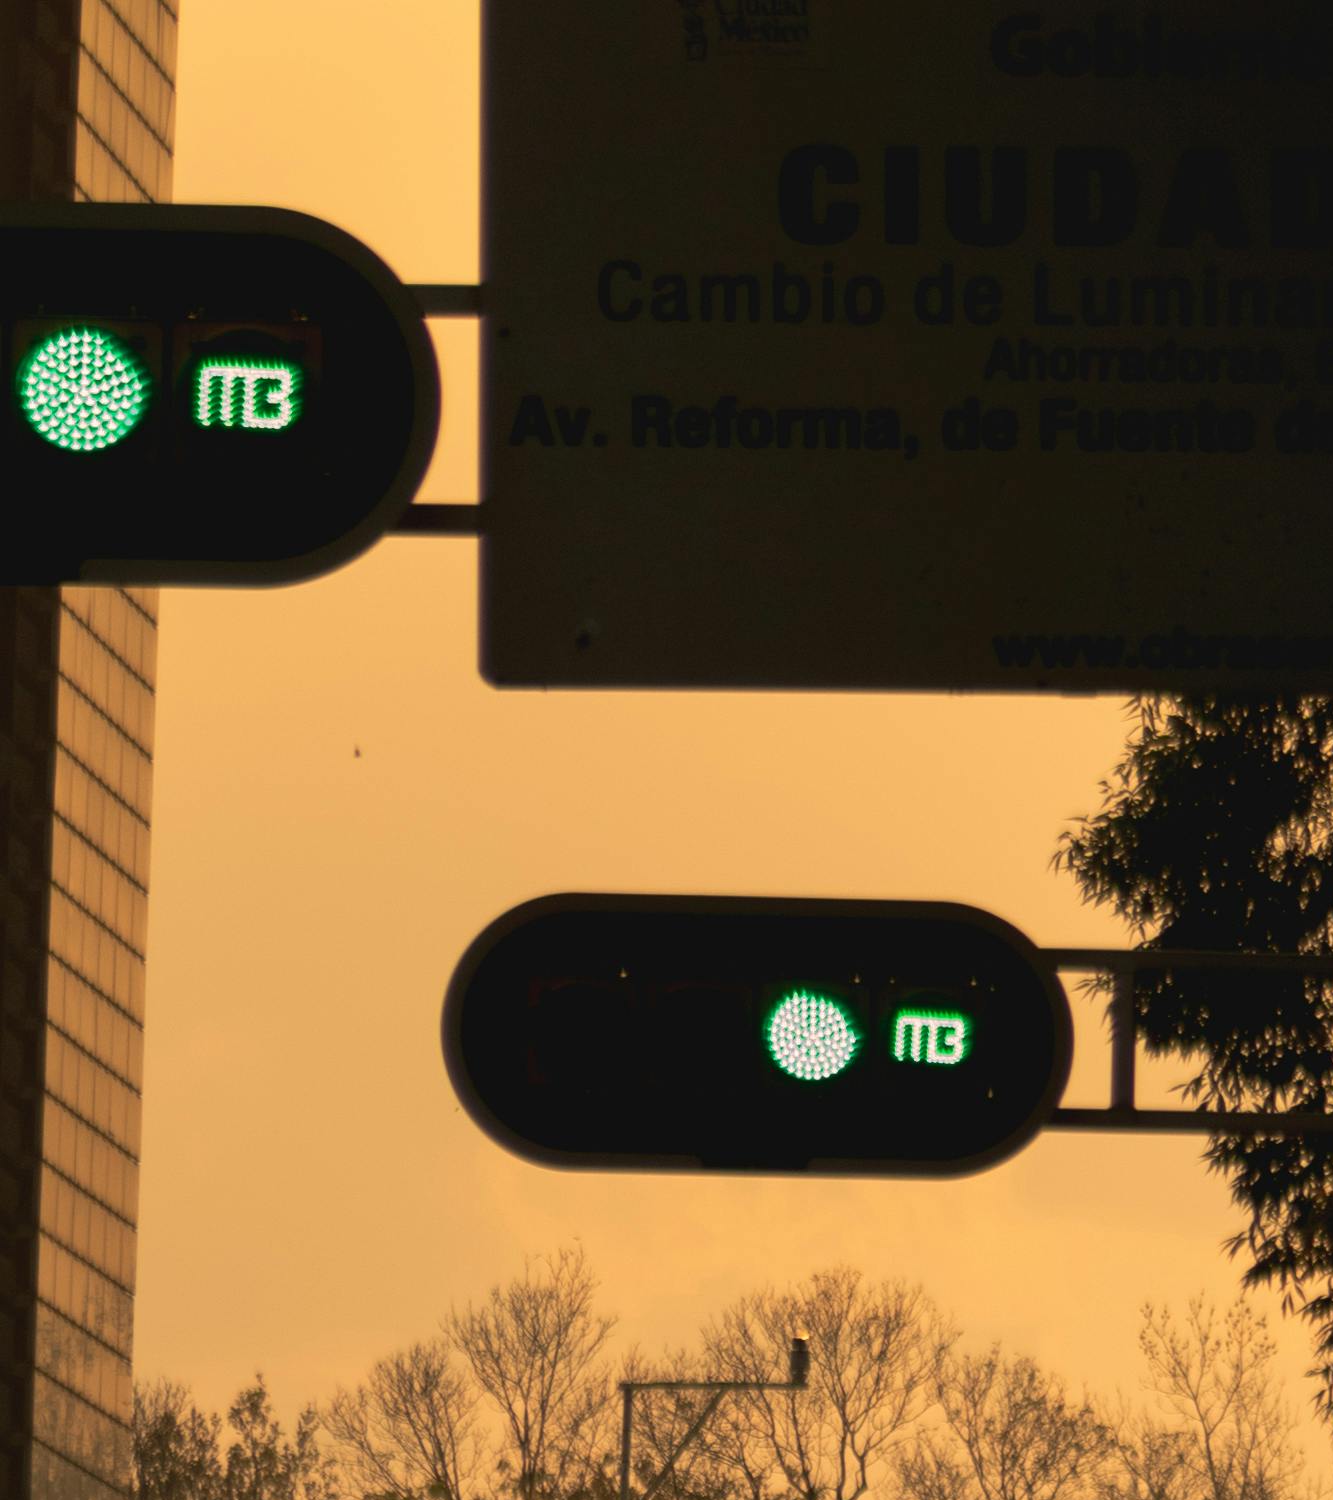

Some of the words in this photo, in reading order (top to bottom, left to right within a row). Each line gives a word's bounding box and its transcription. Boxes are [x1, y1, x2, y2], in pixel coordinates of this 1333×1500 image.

[597, 258, 885, 327] Cambio
[913, 262, 1003, 327] de
[508, 394, 608, 448] Av.
[630, 394, 920, 461] Reforma,
[940, 396, 1021, 453] de
